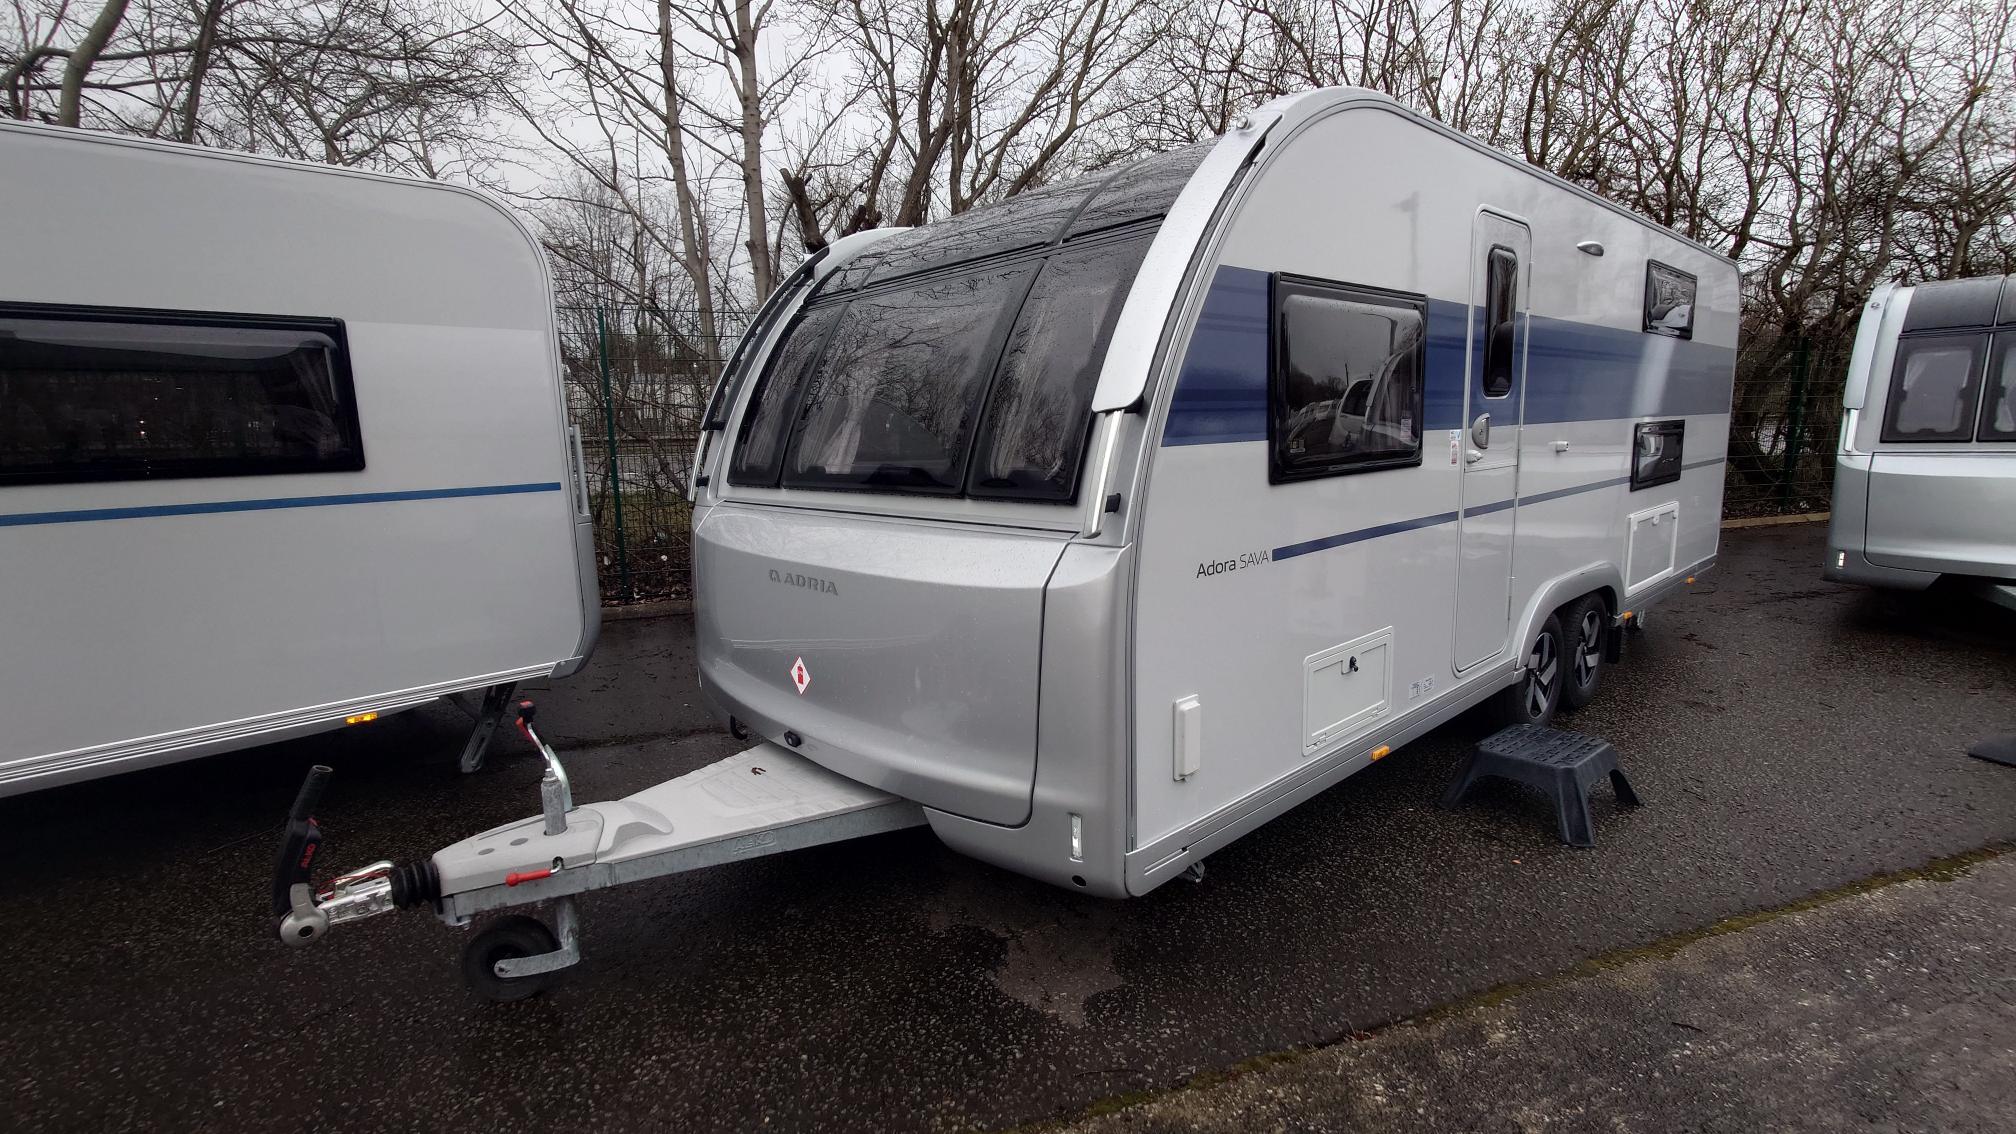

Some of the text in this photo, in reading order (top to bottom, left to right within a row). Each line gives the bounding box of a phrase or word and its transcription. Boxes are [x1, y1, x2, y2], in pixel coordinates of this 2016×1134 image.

[1196, 550, 1269, 579] Adora SAVA
[784, 572, 839, 596] ADRIA
